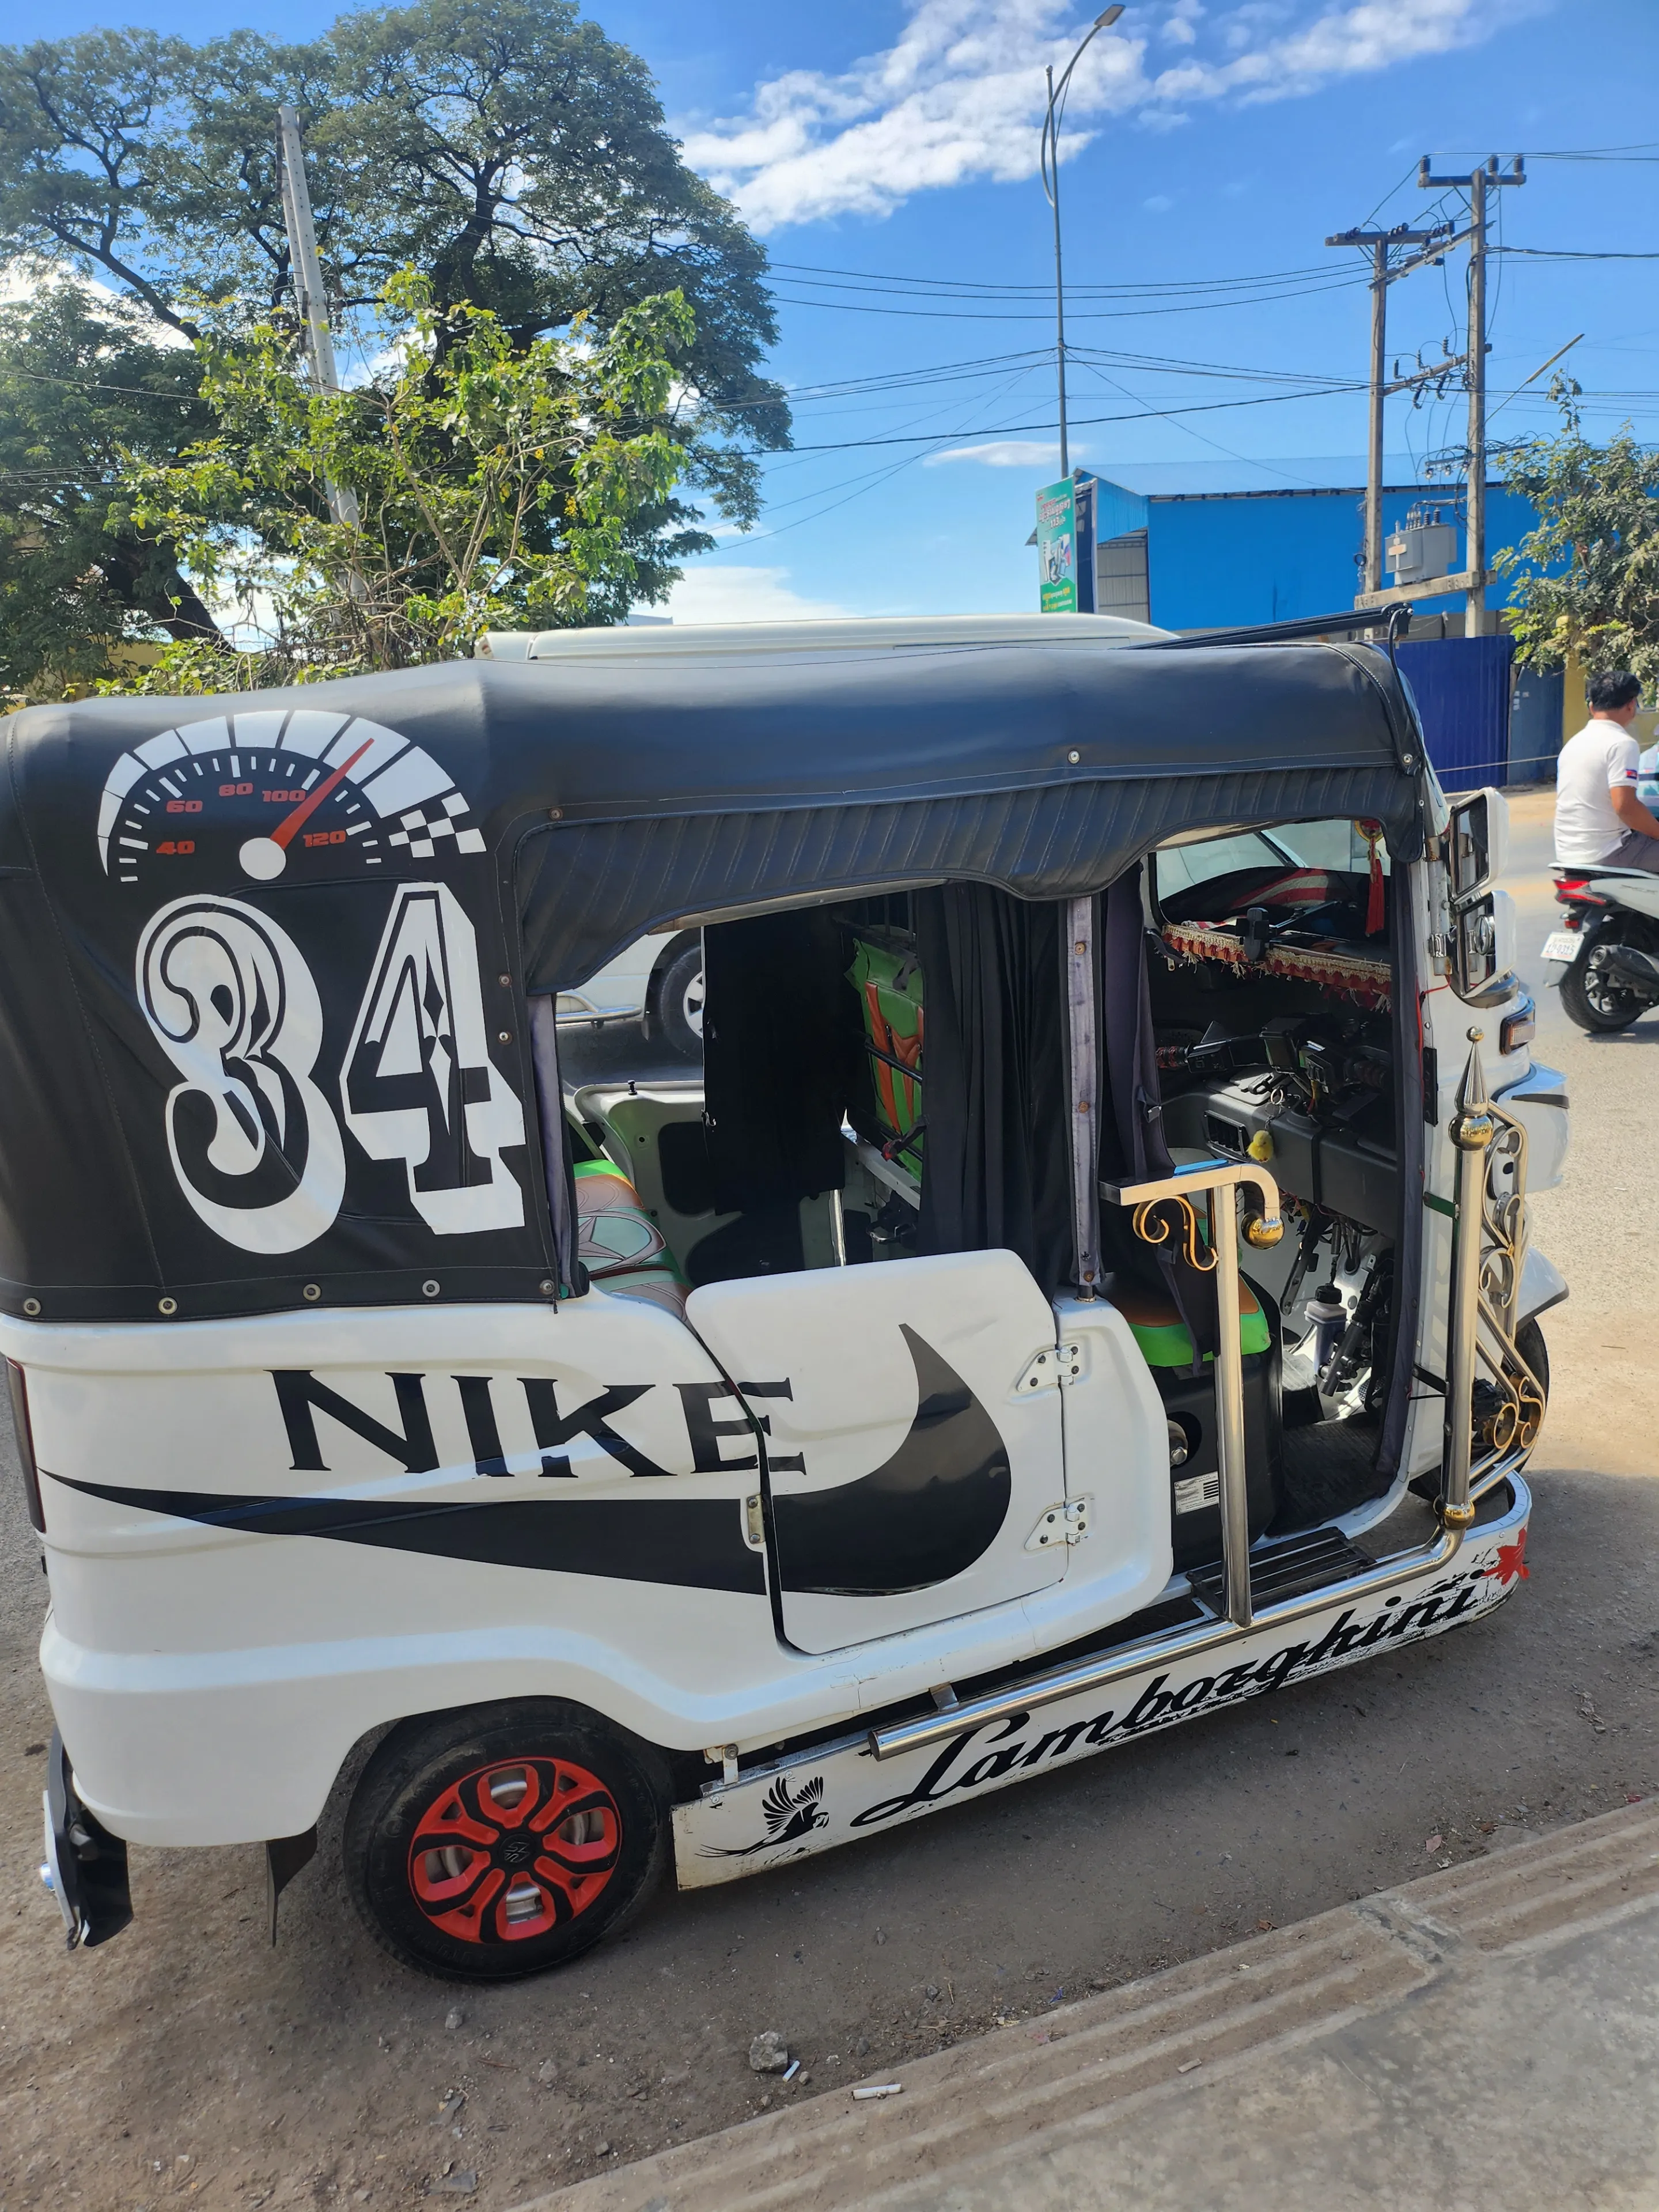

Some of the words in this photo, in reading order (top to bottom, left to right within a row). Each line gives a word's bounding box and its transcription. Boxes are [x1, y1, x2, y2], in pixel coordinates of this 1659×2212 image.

[219, 782, 253, 797] 80
[262, 790, 306, 802] 100
[166, 800, 203, 813] 60
[302, 830, 346, 847] 120
[156, 840, 195, 855] 40
[263, 1369, 806, 1478] NIKE
